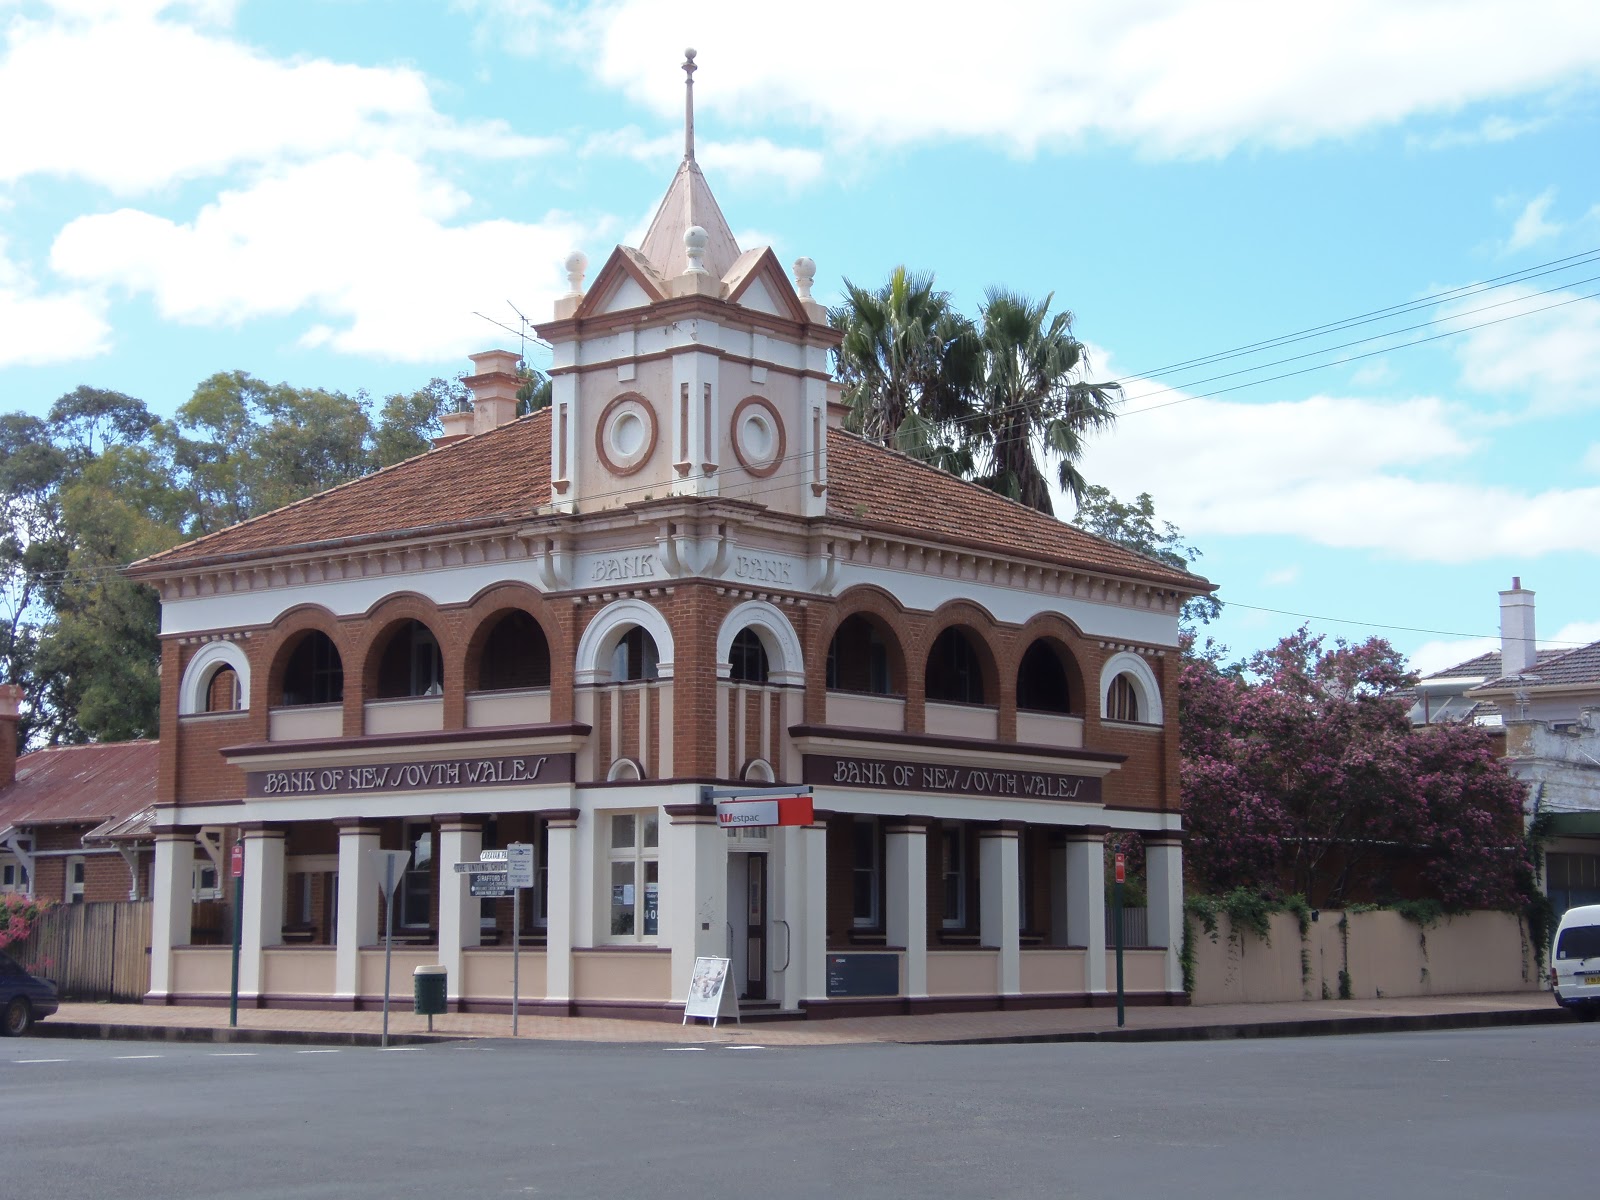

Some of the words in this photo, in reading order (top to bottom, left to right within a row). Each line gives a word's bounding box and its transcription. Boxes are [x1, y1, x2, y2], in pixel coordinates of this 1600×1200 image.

[592, 554, 654, 581] BANK
[735, 555, 792, 584] BANK
[264, 771, 316, 793] BANK
[320, 770, 344, 790] OF
[348, 767, 390, 789] NEW
[465, 757, 548, 782] WALES
[833, 761, 887, 785] BANK
[893, 765, 915, 786] OF
[922, 767, 959, 788] NEW
[1021, 774, 1084, 797] WALES
[719, 813, 760, 823] Westpac
[456, 863, 466, 872] THE
[468, 863, 488, 872] UNITING
[491, 862, 508, 871] CHURC
